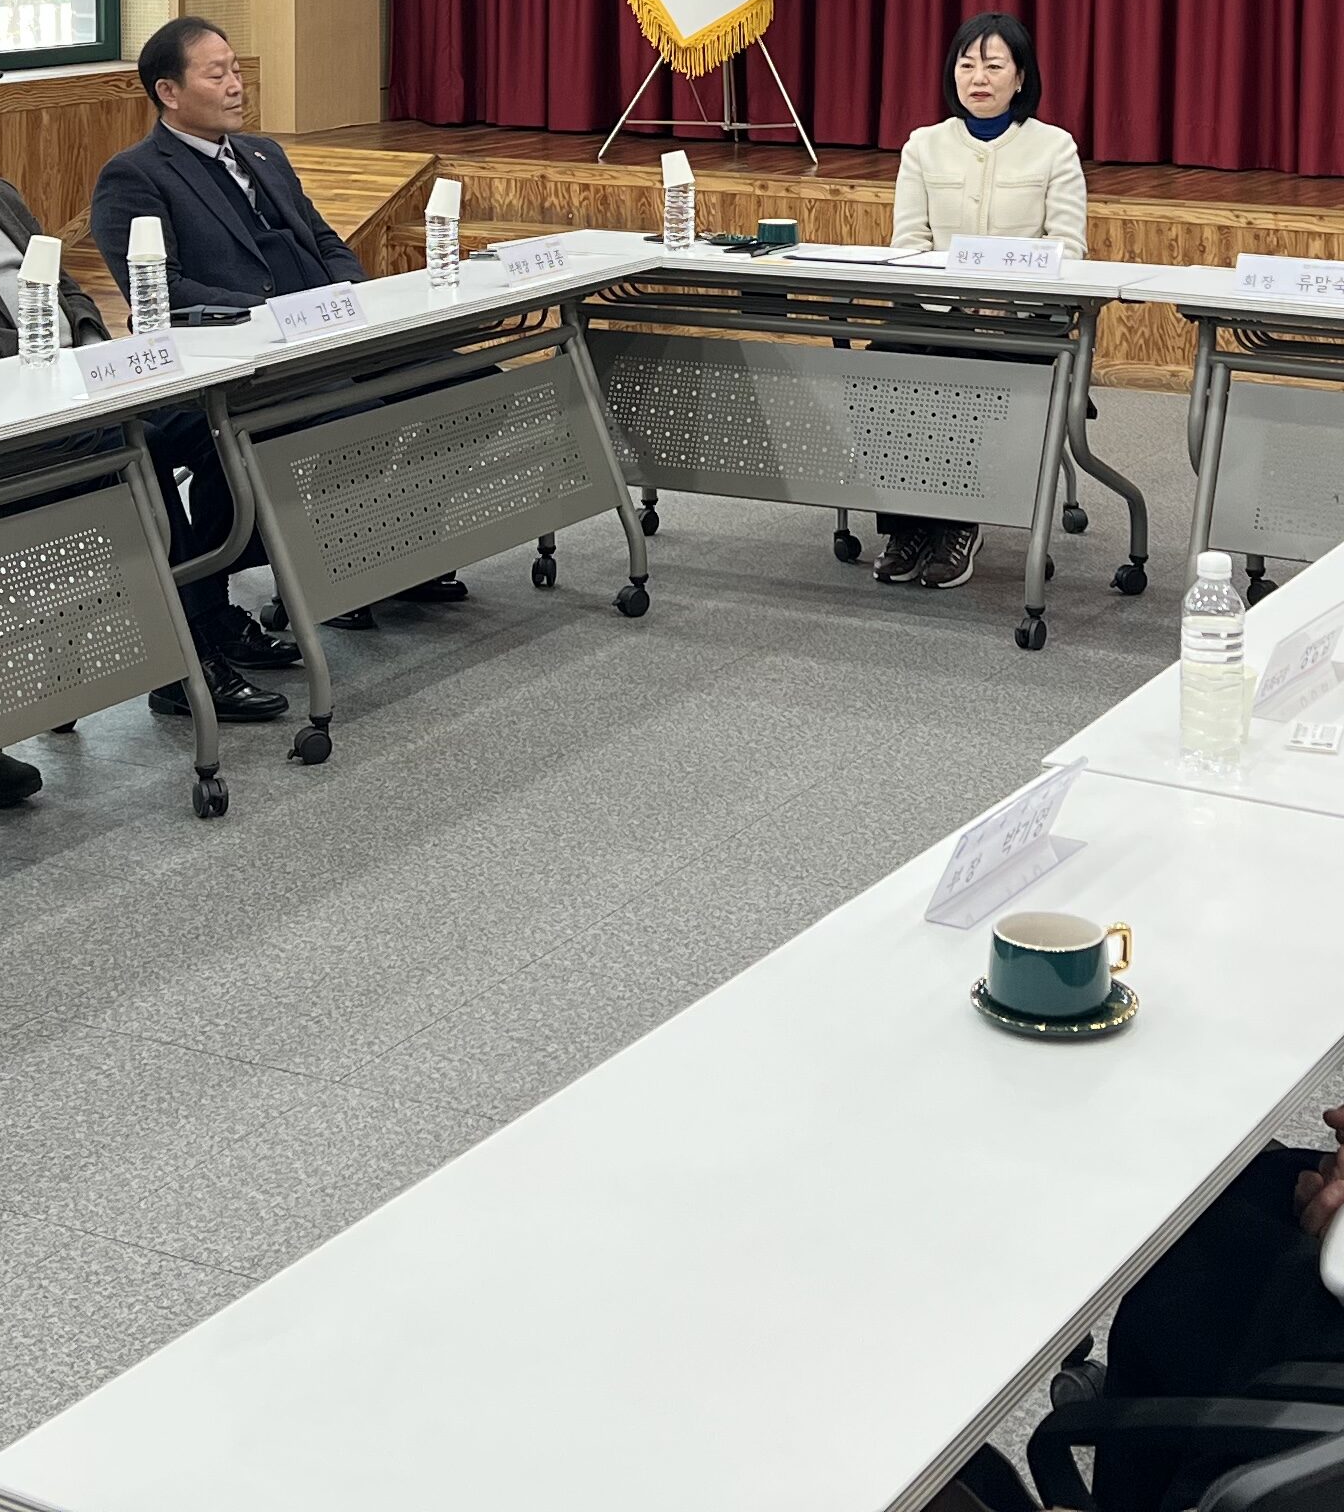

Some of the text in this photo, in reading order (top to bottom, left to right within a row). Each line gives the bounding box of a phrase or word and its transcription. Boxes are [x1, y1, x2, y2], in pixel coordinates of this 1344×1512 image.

[956, 250, 1049, 268] 원장 유지선
[1243, 273, 1275, 289] 회장
[284, 311, 308, 326] 이사
[90, 348, 174, 381] 이사 정찬모
